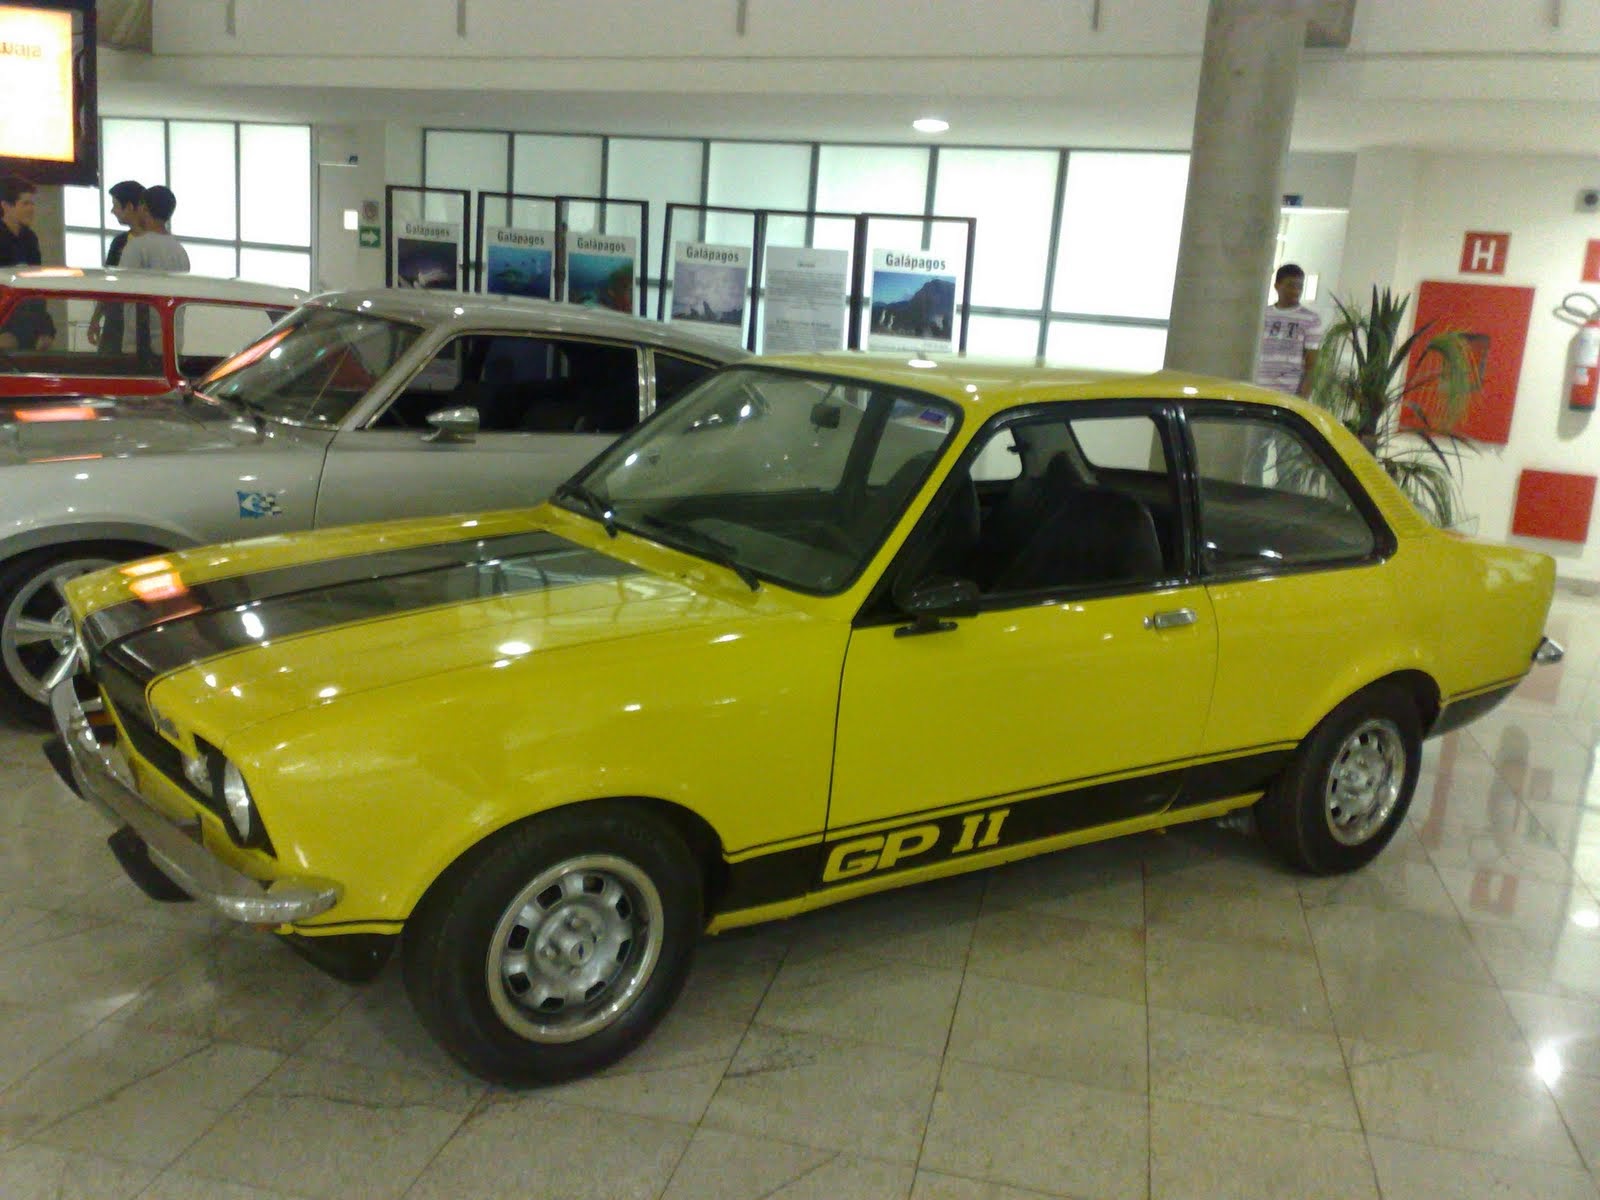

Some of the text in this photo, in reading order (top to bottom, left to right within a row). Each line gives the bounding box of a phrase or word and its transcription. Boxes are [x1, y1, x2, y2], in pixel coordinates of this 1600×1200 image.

[886, 252, 946, 271] Galápagos
[1471, 239, 1496, 270] H
[823, 823, 940, 883] GP
